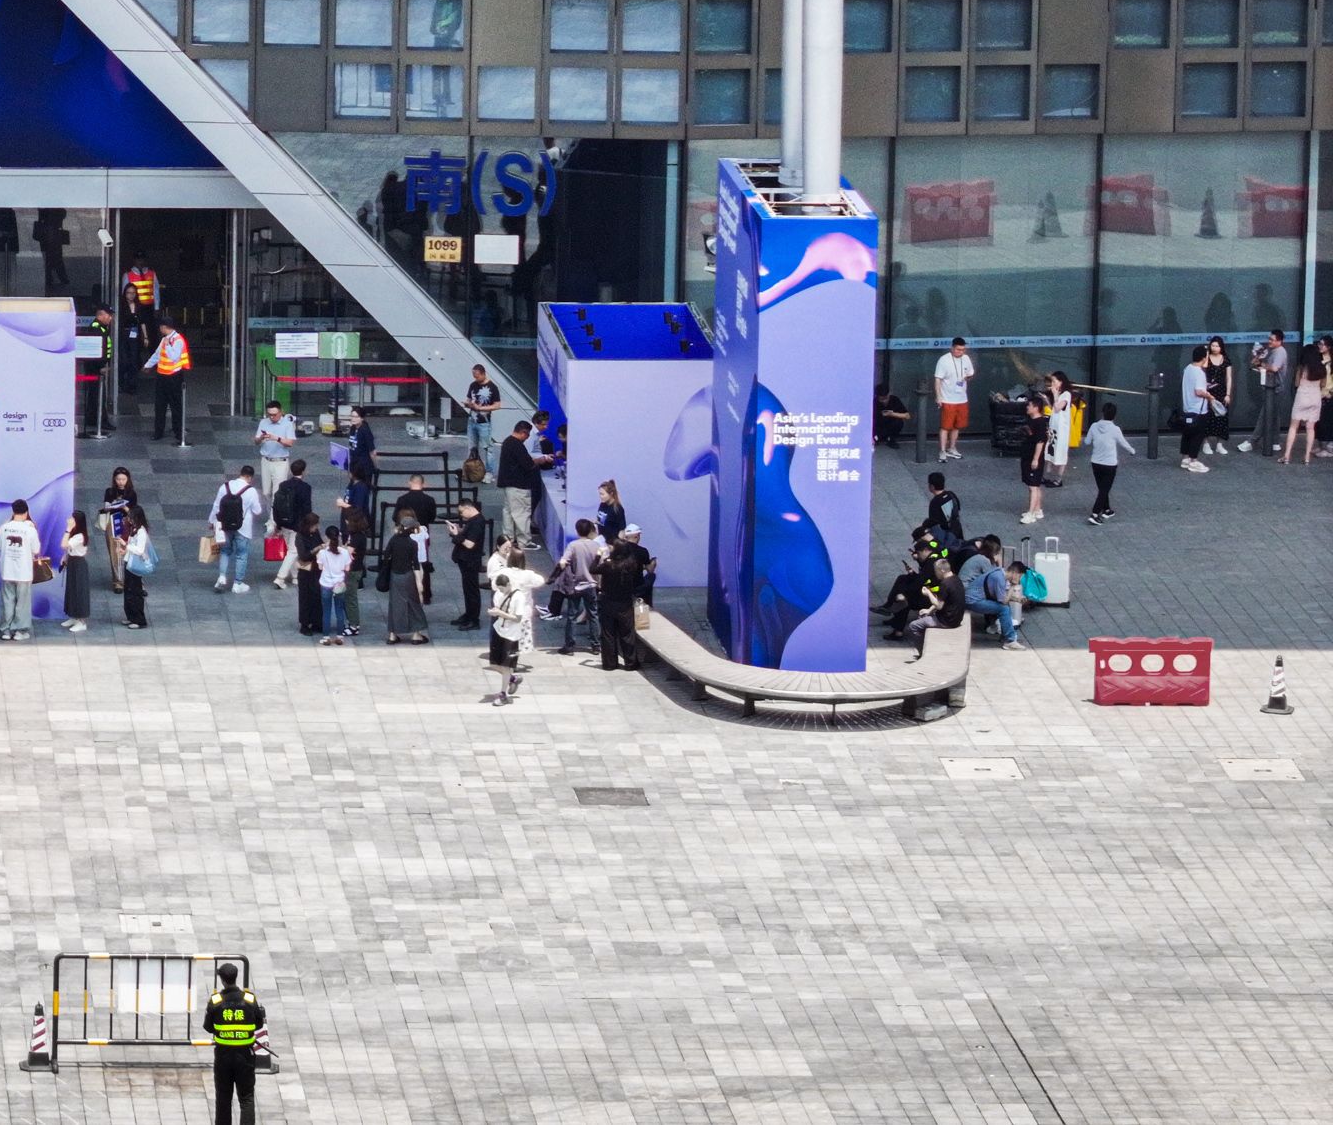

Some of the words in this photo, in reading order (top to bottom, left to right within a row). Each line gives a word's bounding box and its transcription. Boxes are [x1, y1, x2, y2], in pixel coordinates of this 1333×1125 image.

[428, 239, 458, 251] 1099
[2, 412, 28, 420] design
[810, 411, 860, 426] Leading
[773, 423, 852, 434] International
[773, 434, 814, 448] Design
[816, 434, 850, 445] Event
[222, 1009, 245, 1021] 特保
